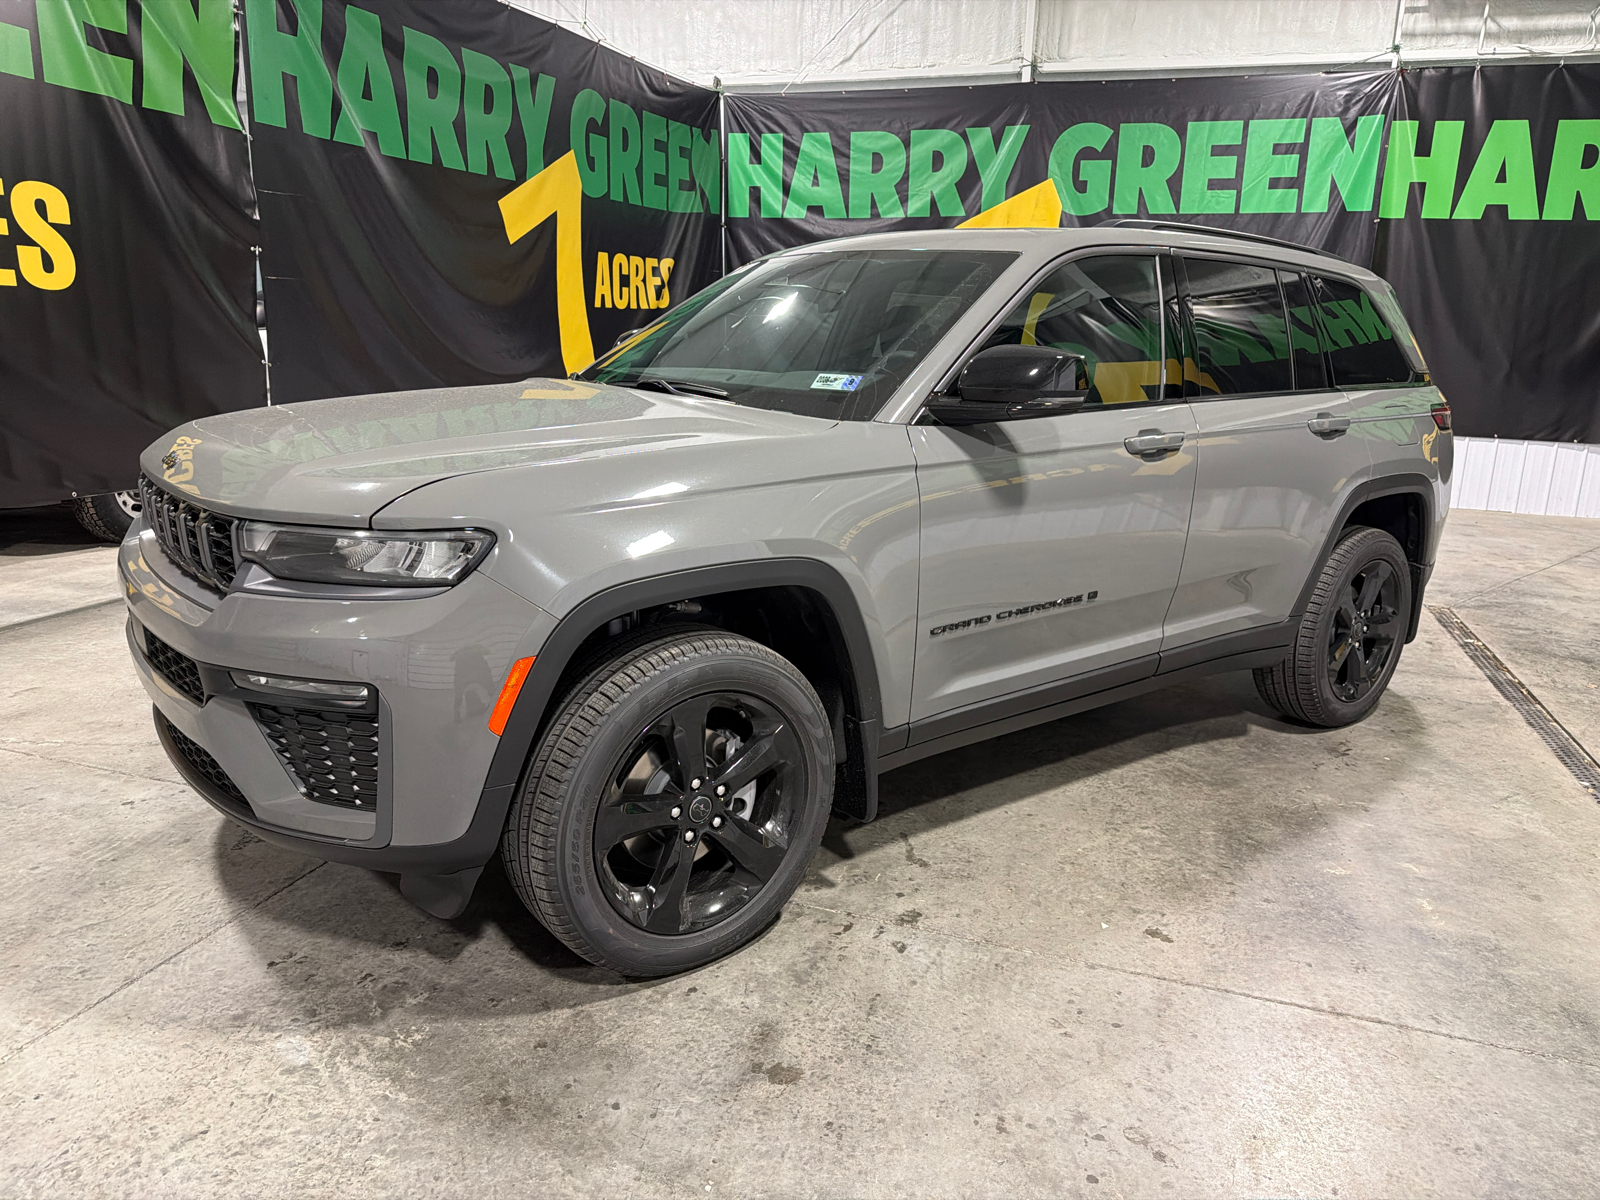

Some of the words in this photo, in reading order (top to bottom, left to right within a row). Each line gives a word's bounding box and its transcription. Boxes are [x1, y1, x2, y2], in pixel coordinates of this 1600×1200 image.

[246, 0, 556, 182] HARRY
[570, 88, 720, 215] GREEN
[728, 124, 1030, 219] HARRY
[1047, 114, 1386, 217] GREEN
[594, 251, 675, 309] ACRES
[929, 614, 992, 636] GRAND
[996, 594, 1084, 620] CHEROKEE
